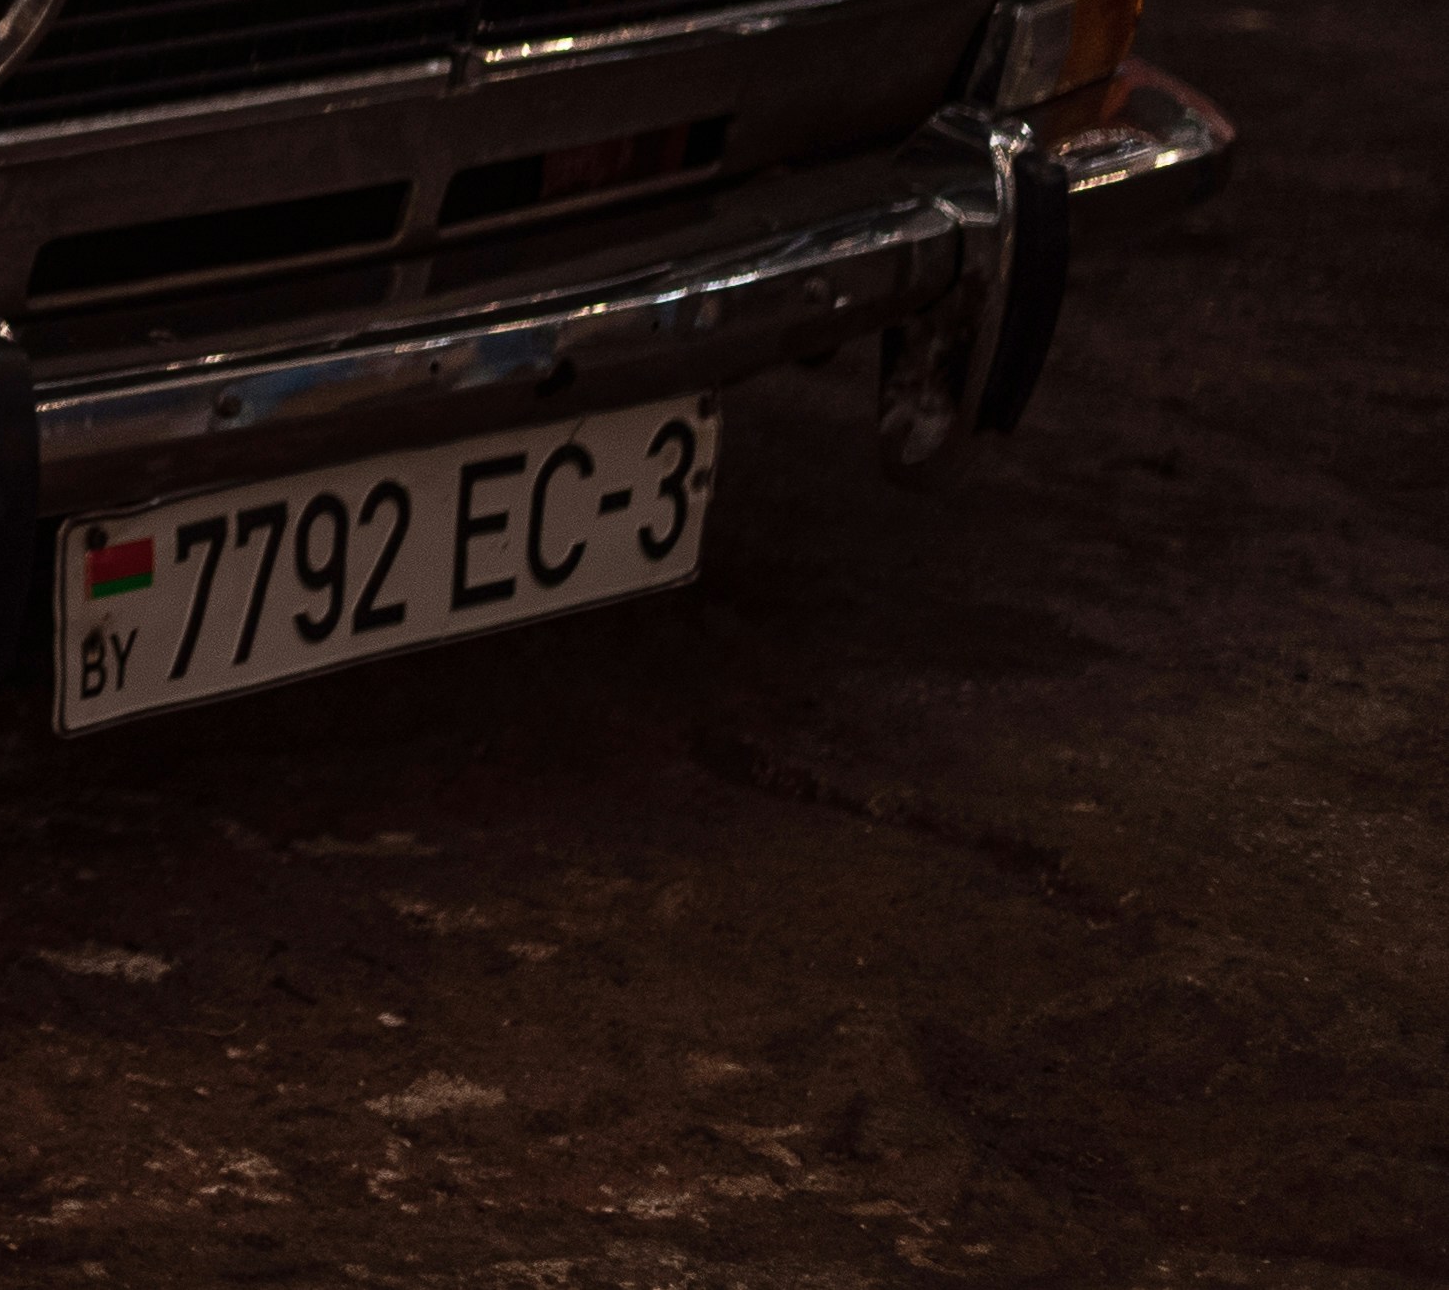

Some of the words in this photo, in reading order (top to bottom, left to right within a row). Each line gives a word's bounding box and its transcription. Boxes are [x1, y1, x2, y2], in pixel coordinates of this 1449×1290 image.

[169, 479, 410, 681] 7792
[450, 420, 699, 612] EC-3
[80, 629, 137, 699] BY
